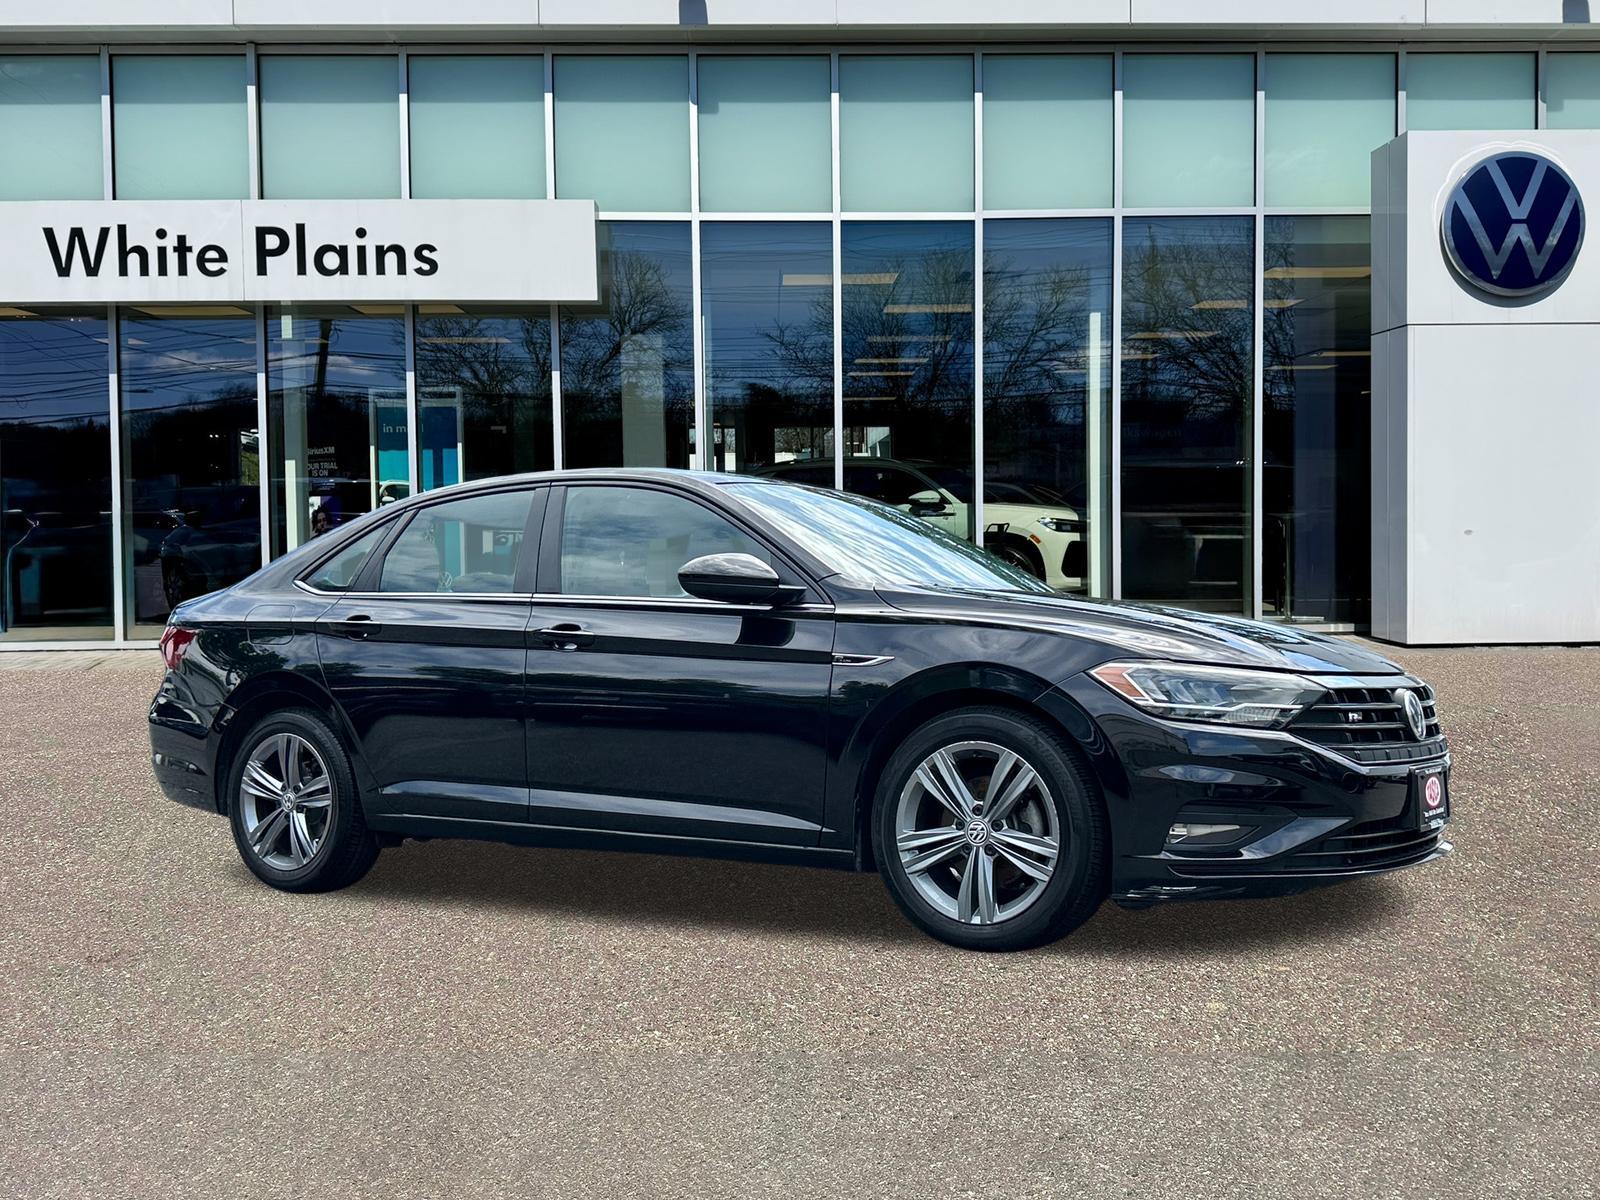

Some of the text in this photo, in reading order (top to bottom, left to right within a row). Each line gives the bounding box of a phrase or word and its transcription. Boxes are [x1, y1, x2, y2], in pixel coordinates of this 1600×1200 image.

[1443, 151, 1586, 296] VW
[42, 223, 438, 277] White Plains
[383, 423, 393, 433] in
[312, 469, 318, 477] IS
